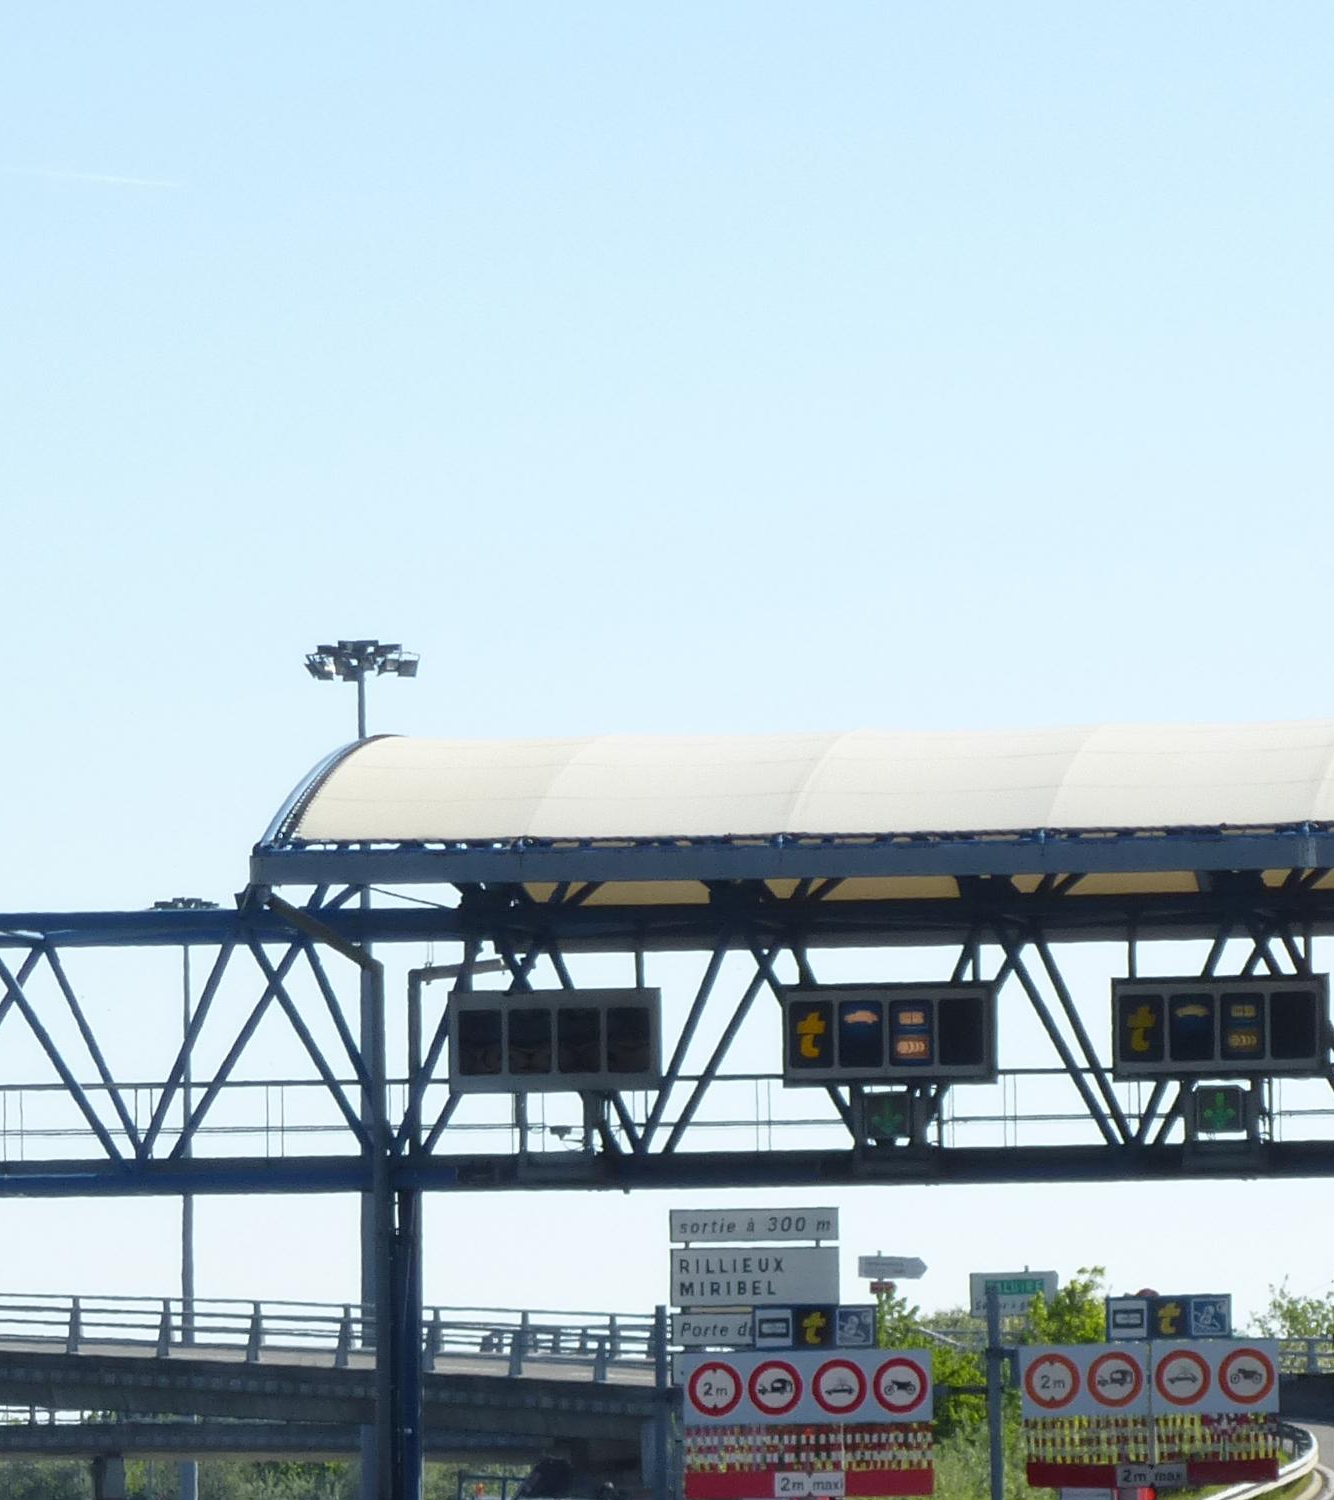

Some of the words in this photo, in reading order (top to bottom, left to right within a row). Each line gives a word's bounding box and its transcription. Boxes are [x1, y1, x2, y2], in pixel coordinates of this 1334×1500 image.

[680, 1218, 736, 1234] sortie
[747, 1217, 755, 1232] à
[767, 1216, 807, 1232] 300
[816, 1221, 831, 1232] m
[680, 1257, 785, 1274] RILLIEUX
[680, 1280, 777, 1297] MIRIBEL
[680, 1321, 728, 1337] Porte
